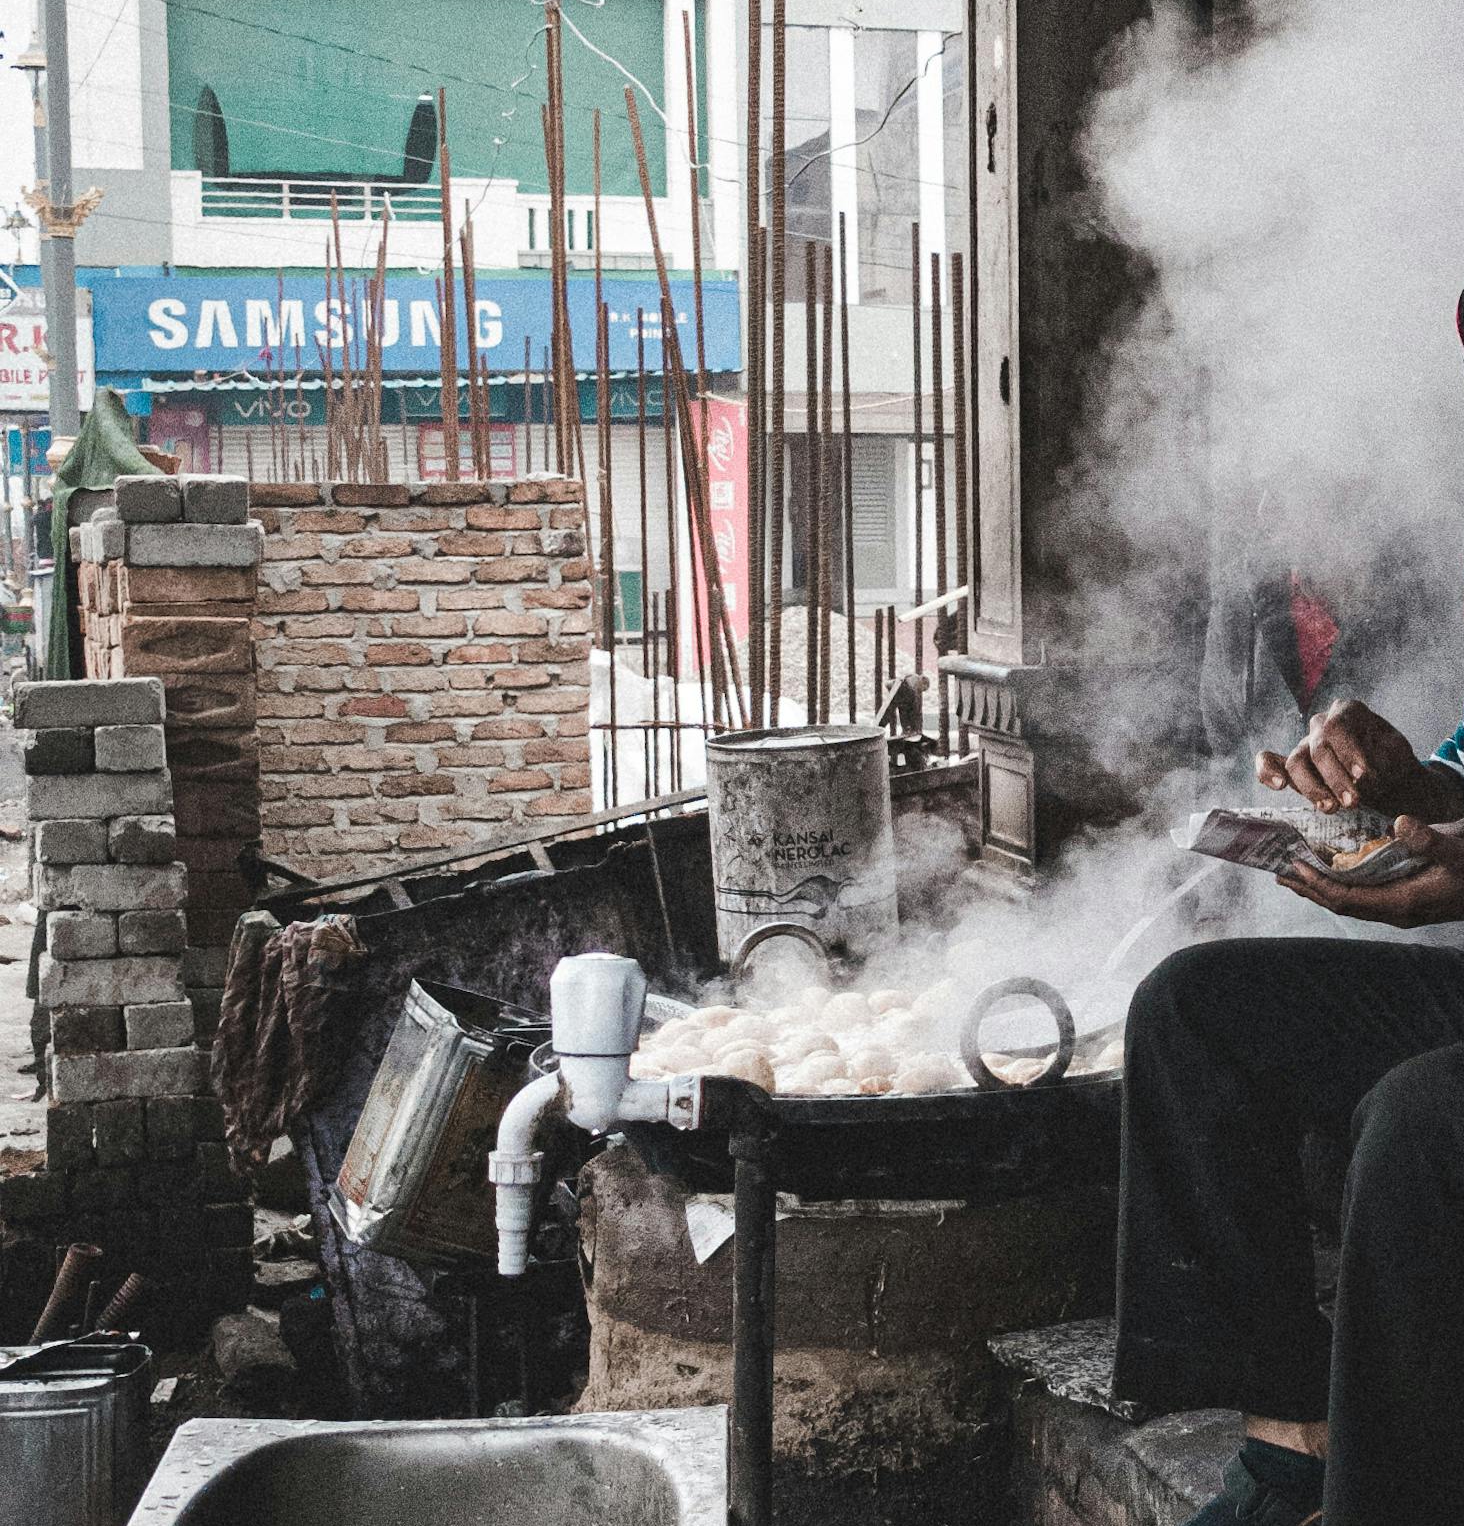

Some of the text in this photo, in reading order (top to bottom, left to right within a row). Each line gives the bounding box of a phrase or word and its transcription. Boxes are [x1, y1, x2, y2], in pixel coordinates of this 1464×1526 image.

[149, 299, 503, 349] SAMSUNG
[630, 328, 671, 339] POIN
[773, 828, 834, 846] KANSAI
[774, 842, 851, 861] NEROLAC
